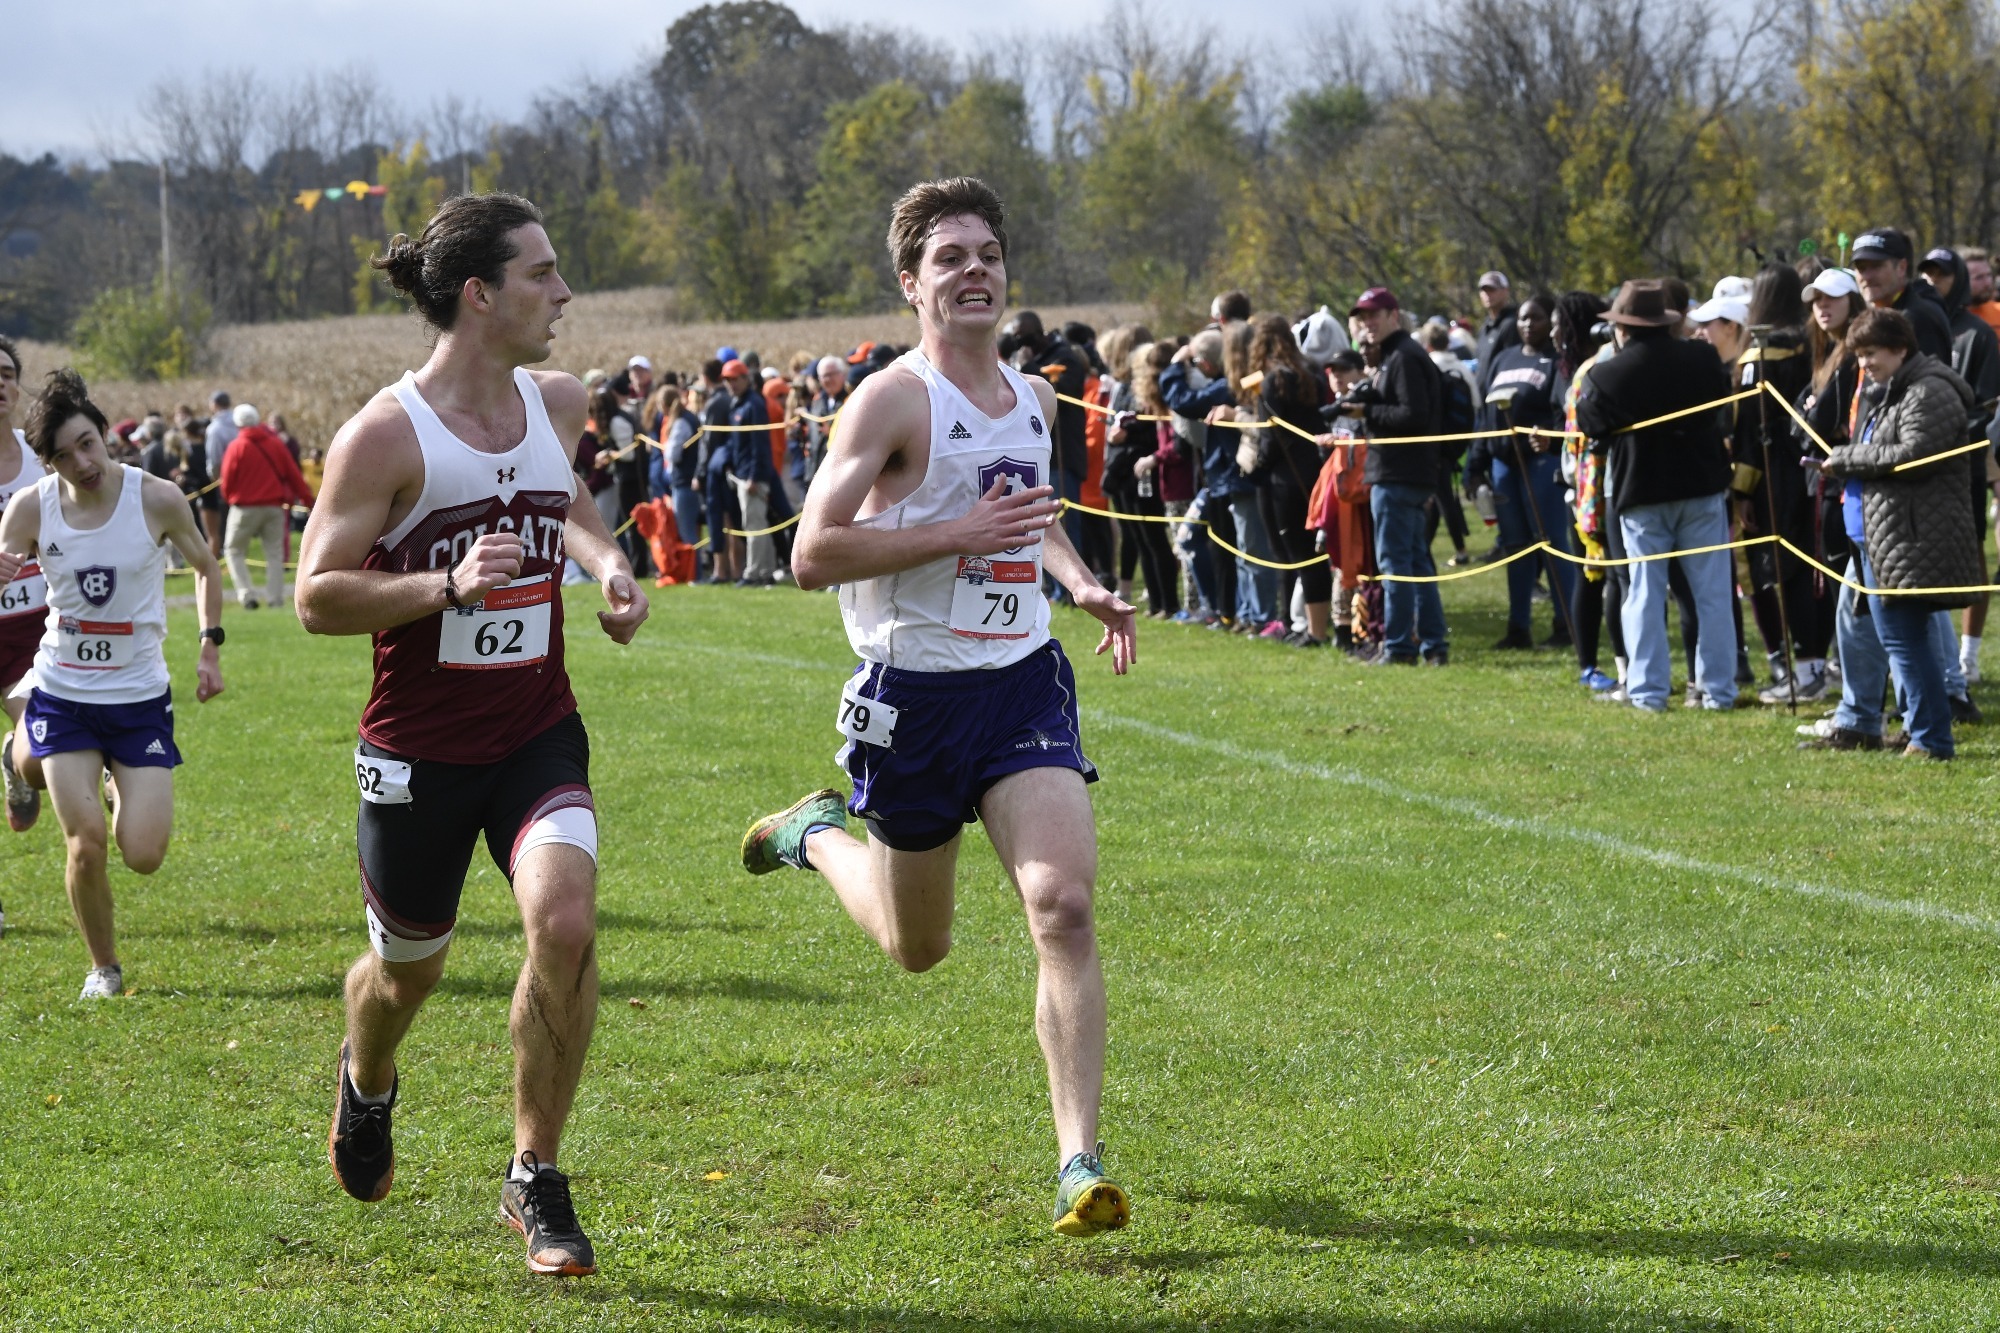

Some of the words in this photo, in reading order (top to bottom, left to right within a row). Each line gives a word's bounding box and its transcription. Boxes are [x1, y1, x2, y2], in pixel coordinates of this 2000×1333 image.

[948, 432, 973, 440] adidas
[1, 585, 31, 610] 64
[981, 592, 1019, 627] 79
[77, 640, 112, 662] 68
[474, 619, 524, 657] 62
[840, 697, 871, 733] 79
[1015, 740, 1036, 749] HOLY
[356, 762, 385, 796] 62
